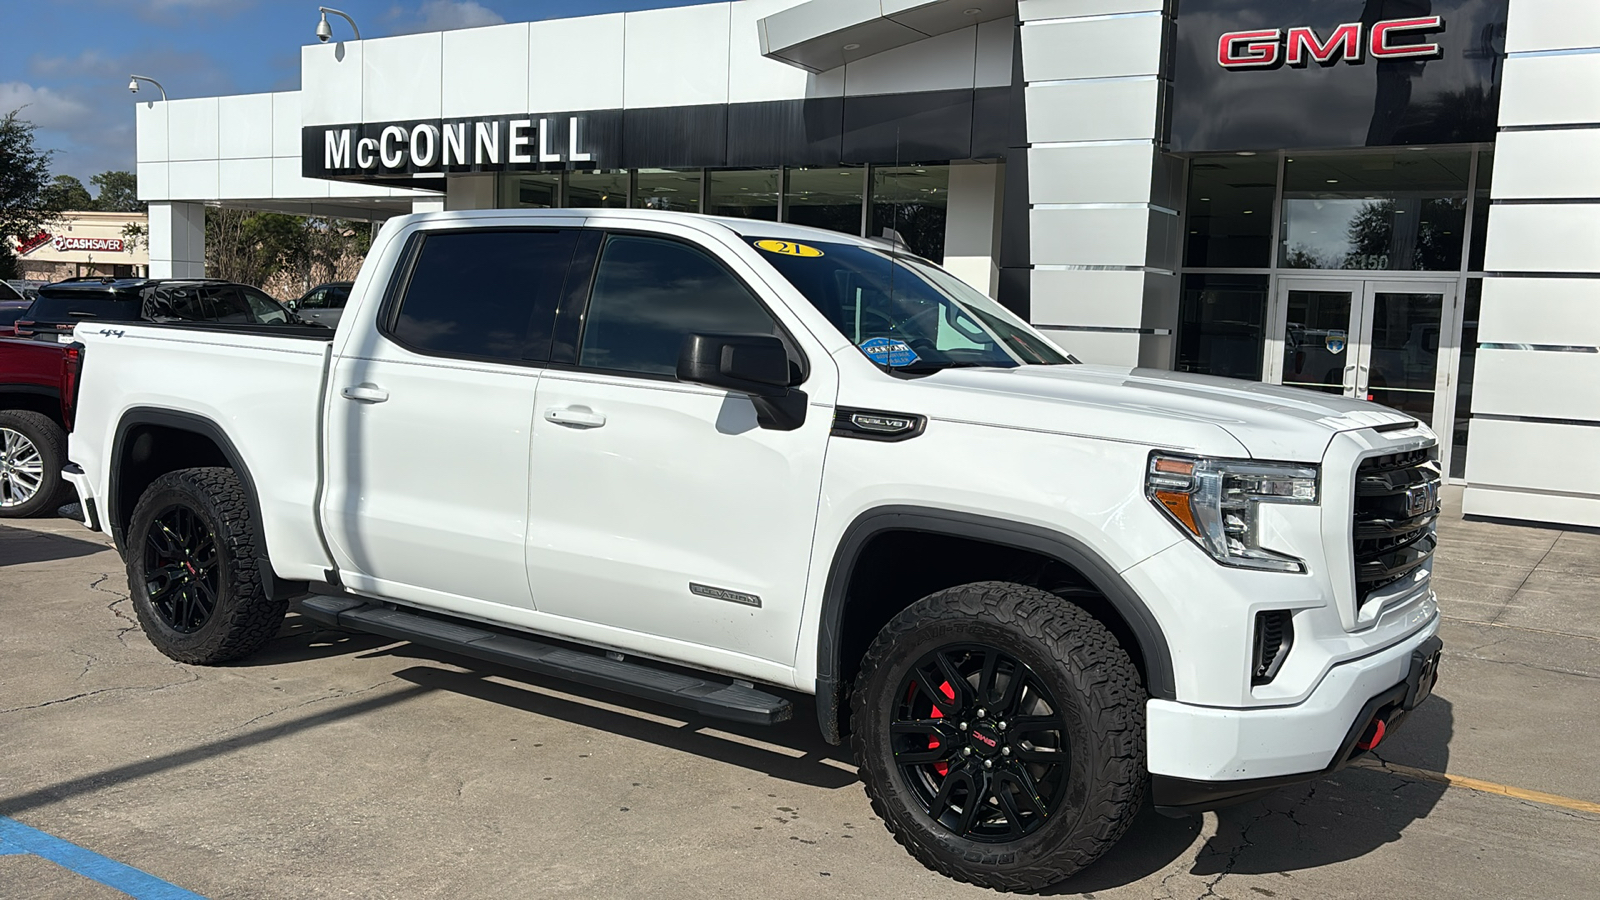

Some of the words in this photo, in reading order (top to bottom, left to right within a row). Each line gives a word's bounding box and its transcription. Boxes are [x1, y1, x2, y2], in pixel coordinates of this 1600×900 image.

[1217, 15, 1442, 68] GMC
[324, 116, 593, 170] McCONNELL
[776, 242, 804, 255] 21
[692, 584, 760, 606] ELEVATION
[972, 729, 997, 747] GMC
